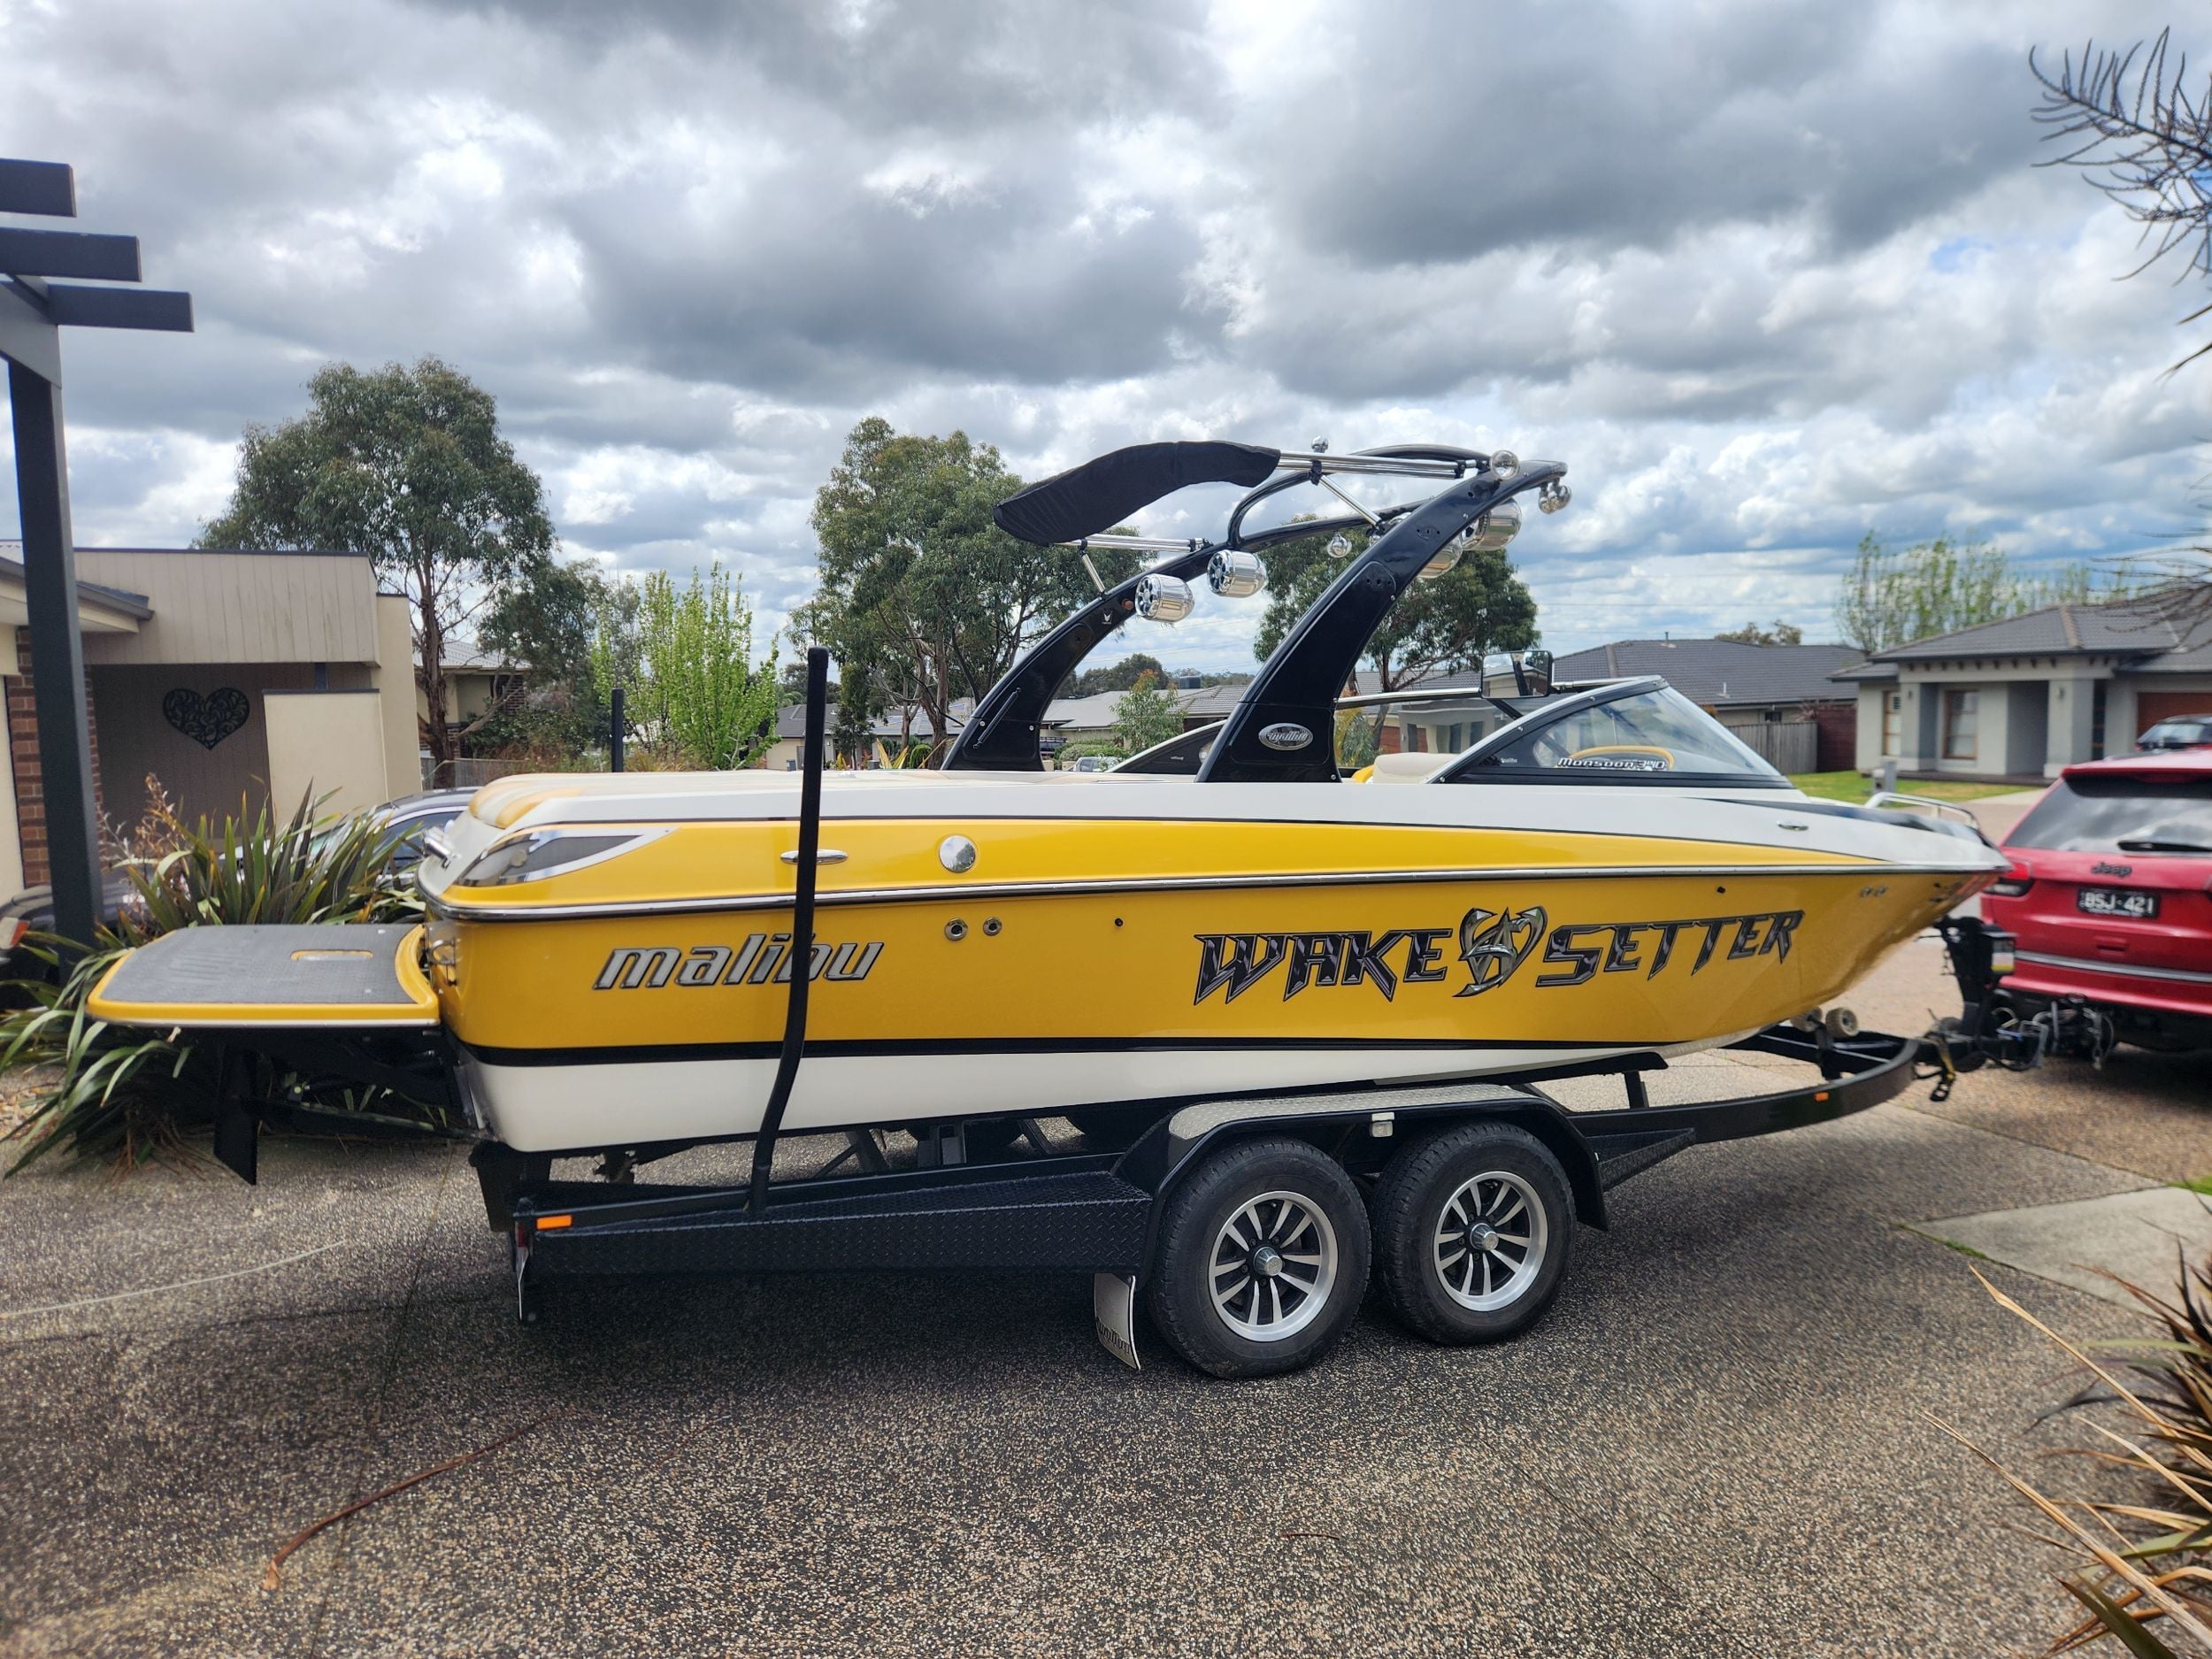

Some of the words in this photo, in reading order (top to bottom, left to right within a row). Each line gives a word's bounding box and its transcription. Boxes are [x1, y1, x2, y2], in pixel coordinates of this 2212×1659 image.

[2091, 862, 2132, 878] Jeep
[592, 933, 885, 990] malibu
[1194, 929, 1453, 1005] WAKE
[1535, 910, 1804, 987] SETTER
